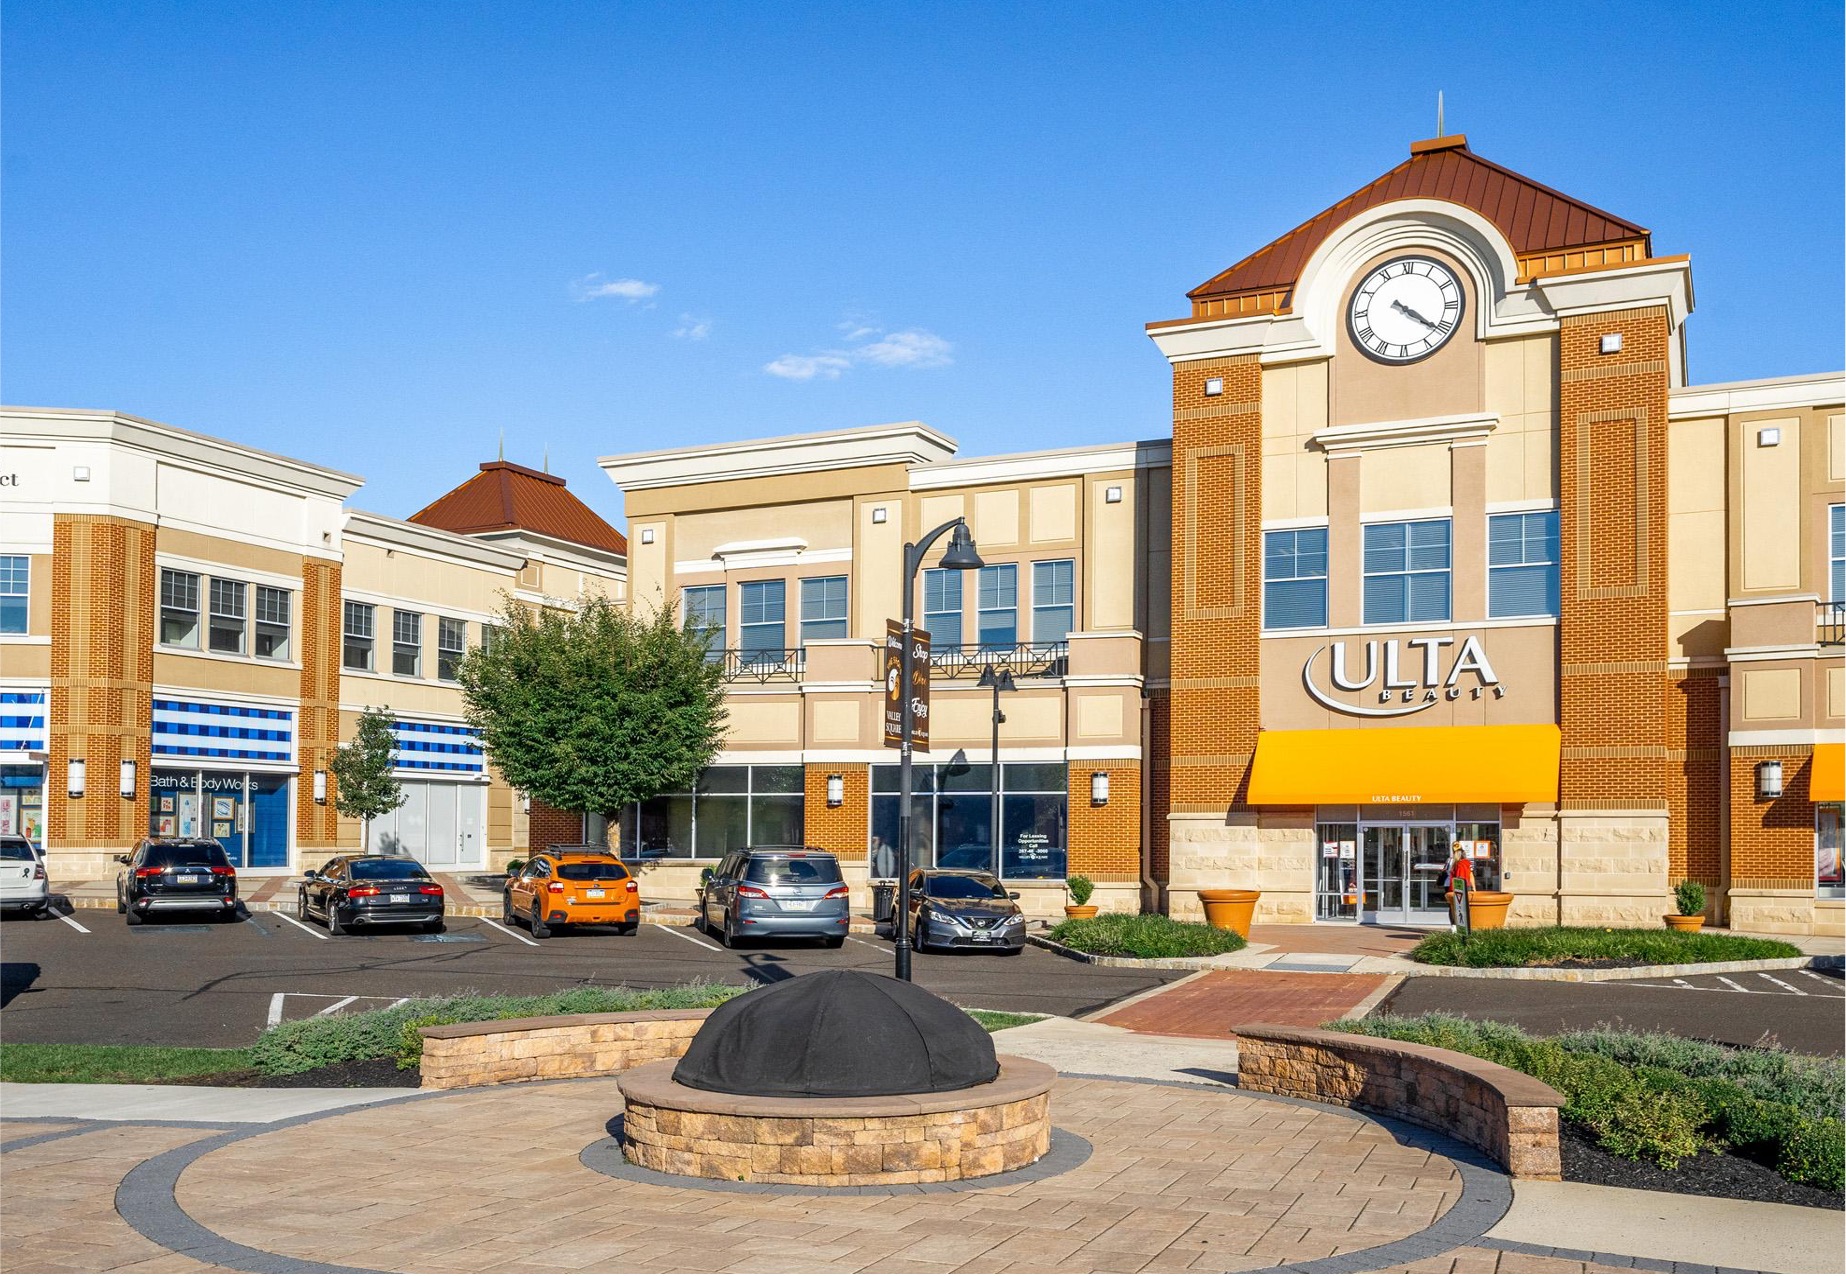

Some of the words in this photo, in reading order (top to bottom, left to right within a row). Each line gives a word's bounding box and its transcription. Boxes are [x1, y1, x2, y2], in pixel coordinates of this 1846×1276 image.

[912, 643, 929, 664] Shop
[1331, 635, 1499, 691] ULTA
[1379, 685, 1509, 704] BEAUTY
[911, 697, 928, 719] Enjoy
[151, 775, 178, 788] Bath
[179, 776, 189, 788] &
[1391, 794, 1422, 802] BEAUTY
